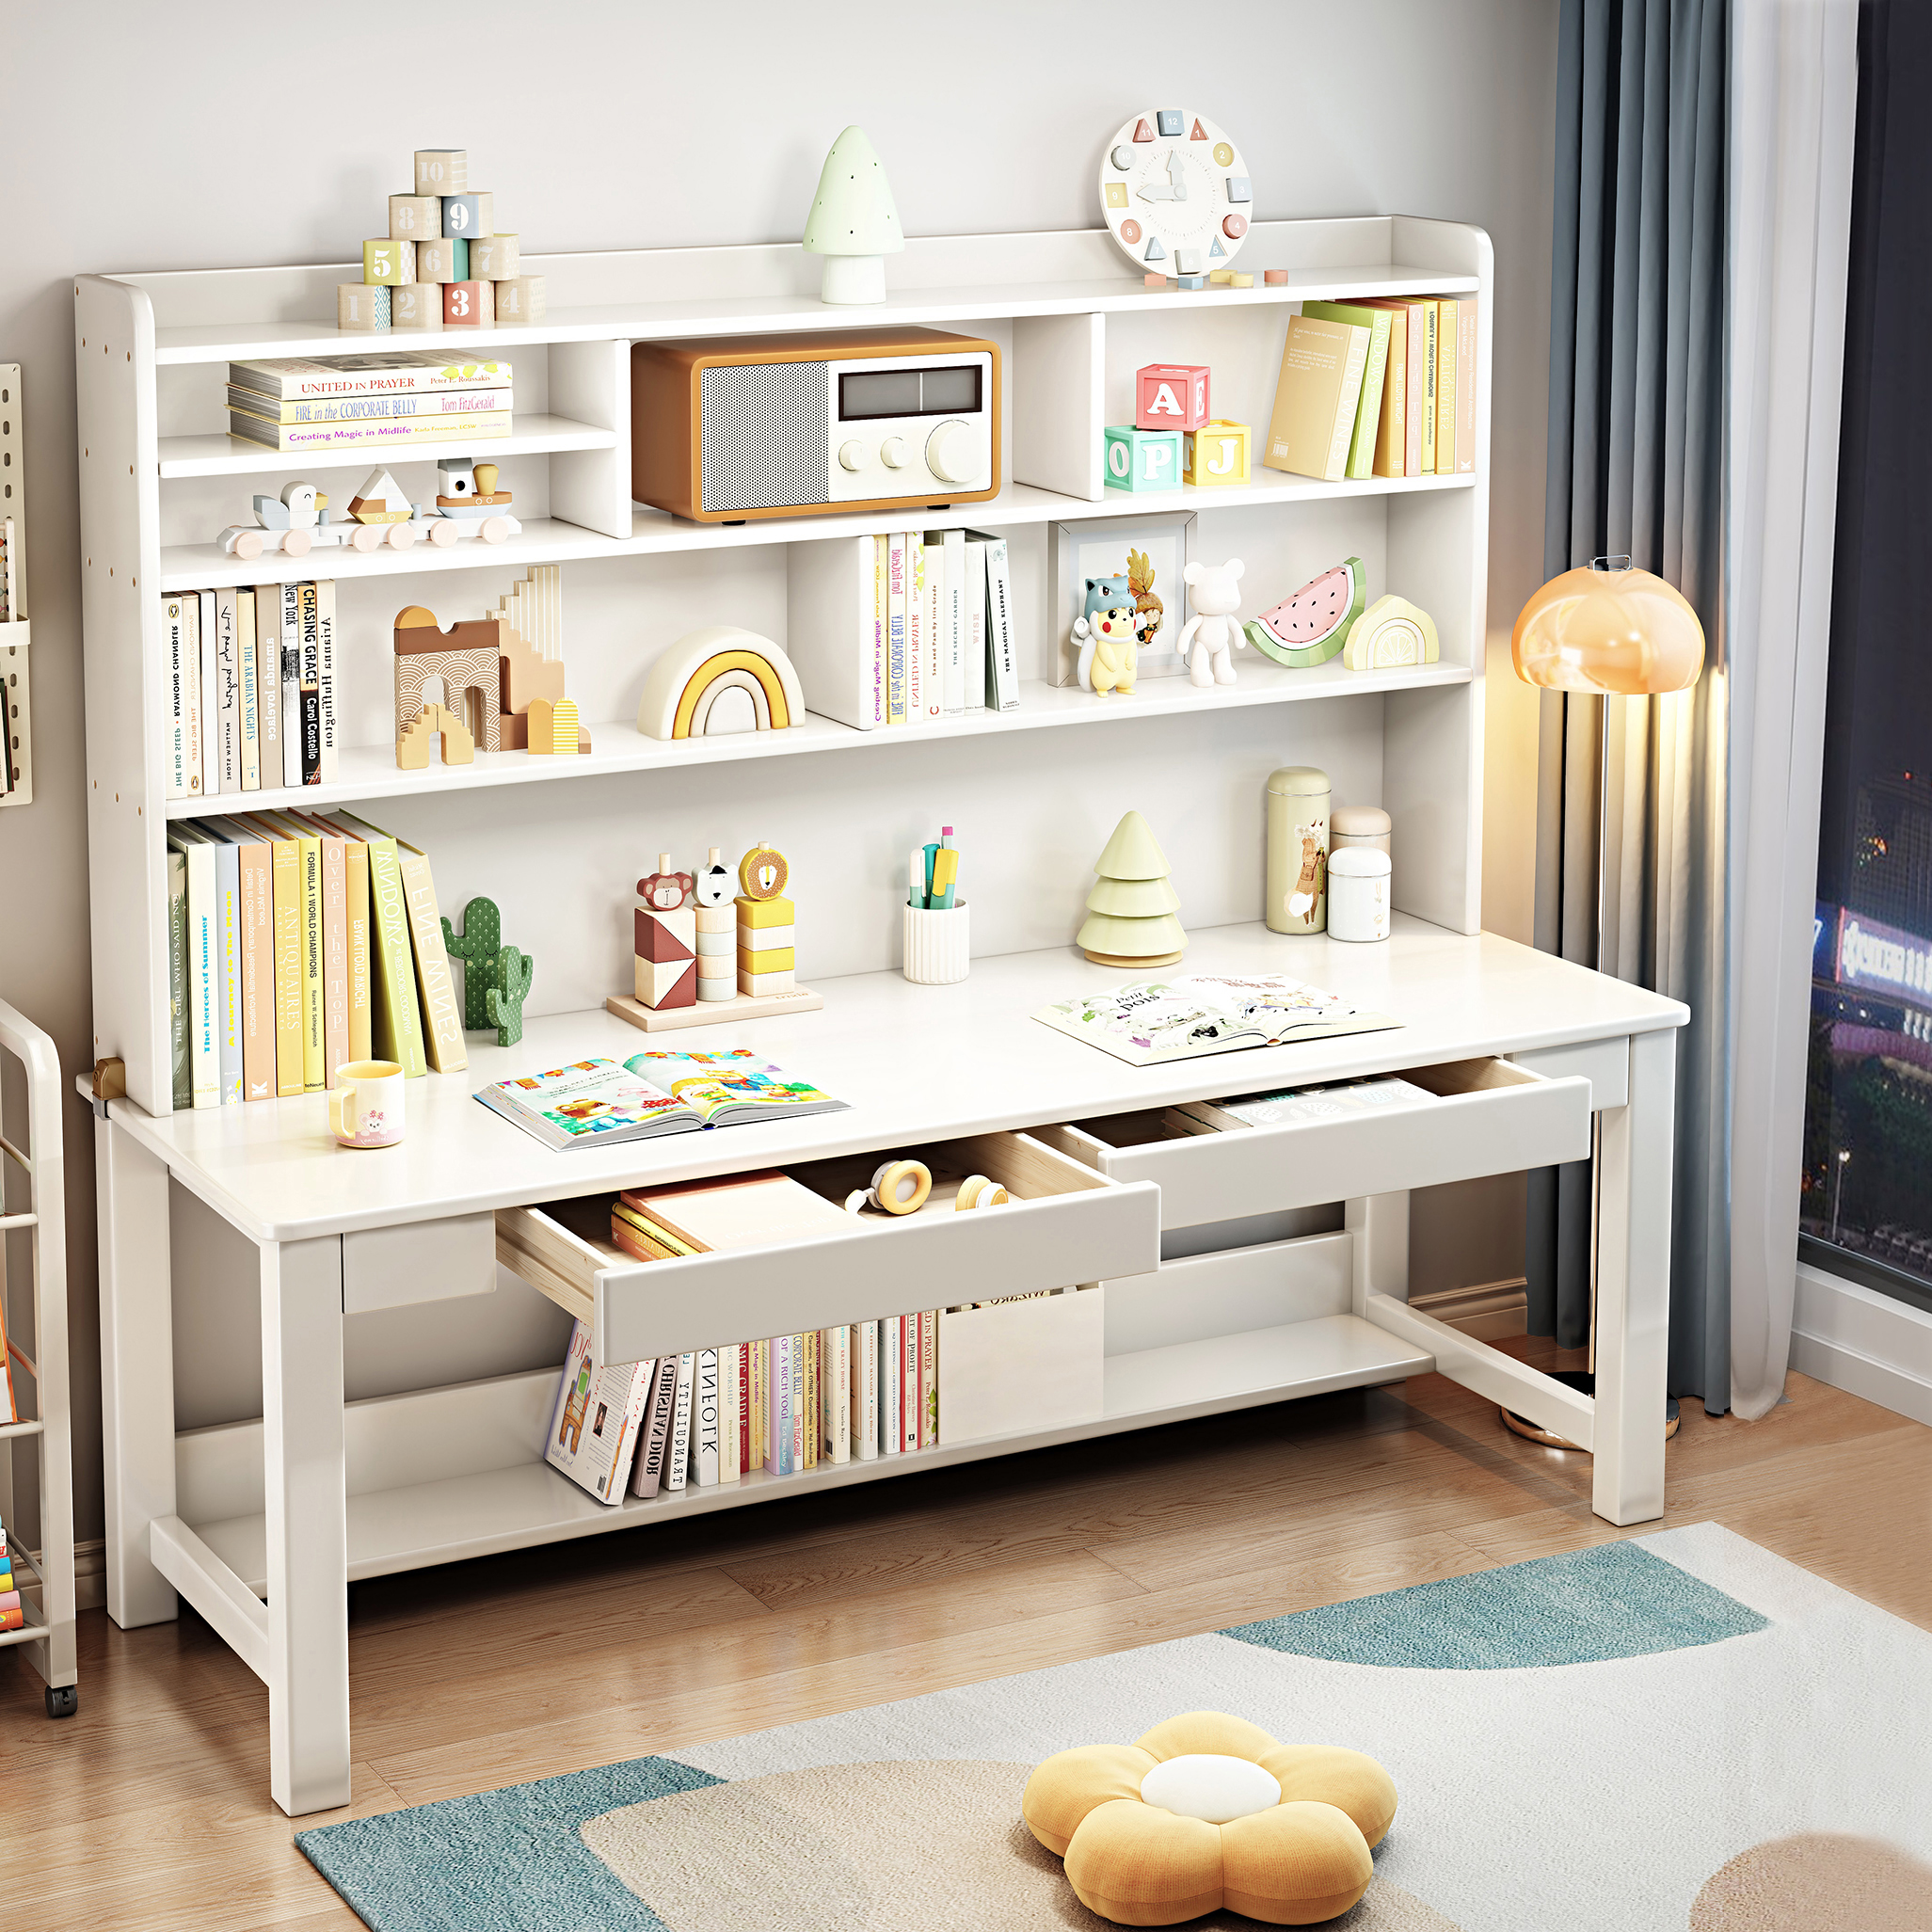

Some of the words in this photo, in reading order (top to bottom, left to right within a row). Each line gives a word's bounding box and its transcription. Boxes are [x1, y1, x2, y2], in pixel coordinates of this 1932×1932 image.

[1168, 118, 1178, 126] 12
[1219, 151, 1225, 159] 2
[420, 161, 444, 182] 10
[1111, 192, 1118, 200] 9
[398, 206, 415, 231] 8
[449, 202, 470, 231] 9
[1126, 228, 1133, 236] 8
[373, 249, 391, 278] 5
[425, 248, 441, 272] 6
[477, 246, 494, 272] 7
[348, 295, 360, 322] 1
[398, 292, 416, 319] 2
[451, 289, 470, 317] 3
[502, 287, 520, 313] 4
[1368, 316, 1389, 386] WINDOWS
[457, 374, 491, 383] Roussakis
[1345, 347, 1365, 391] FINE
[1396, 363, 1404, 382] FRANK
[300, 381, 353, 393] UNITED
[355, 381, 367, 390] IN
[369, 377, 416, 389] PRAYER
[1395, 383, 1403, 402] LLOYD
[295, 405, 312, 422] FIRE
[314, 405, 324, 420] in
[325, 403, 339, 420] the
[340, 400, 391, 420] CORPORATE
[392, 398, 417, 415] BELLY
[441, 397, 457, 411] Tom
[458, 395, 495, 410] FitzGerald
[1146, 382, 1185, 416] A
[1195, 379, 1205, 418] E
[1395, 402, 1403, 424] WRIGHT
[288, 431, 331, 442] Creating
[333, 429, 363, 439] Magic
[377, 425, 412, 436] Midlife
[431, 424, 458, 433] Freeman,
[1333, 398, 1355, 461] WINES
[1364, 419, 1373, 449] GOODMAN
[1109, 440, 1129, 477] O
[1142, 444, 1173, 481] P
[1206, 439, 1238, 474] J
[284, 584, 297, 603] New
[998, 579, 1006, 618] ELEPHANT
[285, 605, 298, 626] York
[303, 588, 316, 644] CHASING
[932, 621, 938, 631] By
[243, 645, 253, 663] THE
[264, 637, 275, 687] amanda
[304, 646, 317, 685] GRACE
[244, 664, 254, 704] ARABIAN
[263, 689, 277, 741] lovelace
[306, 697, 317, 722] Carol
[246, 707, 256, 741] NIGHTS
[307, 724, 318, 759] Costello
[307, 851, 315, 891] FORMULA
[327, 847, 342, 905] Over
[308, 899, 316, 929] WORLD
[309, 930, 317, 979] CHAMPIONS
[331, 923, 342, 966] the
[202, 972, 209, 984] of
[227, 959, 233, 974] to
[284, 906, 300, 1030] ANTIQUAIRES
[331, 980, 343, 1030] Top
[1115, 991, 1143, 1004] Petit
[1119, 994, 1160, 1012] pois
[229, 1035, 234, 1046] A
[908, 1330, 916, 1340] OF
[924, 1325, 932, 1333] IN
[780, 1337, 789, 1353] OF
[793, 1335, 803, 1380] CORPORATE
[907, 1343, 916, 1373] PROFIT
[924, 1334, 933, 1371] PRAYER
[780, 1355, 789, 1364] A
[780, 1365, 789, 1391] RICH
[793, 1380, 803, 1396] BELLY
[780, 1392, 789, 1420] YOGI
[780, 1426, 788, 1436] Ed
[793, 1413, 802, 1427] Tom
[793, 1427, 802, 1457] FitzGerald
